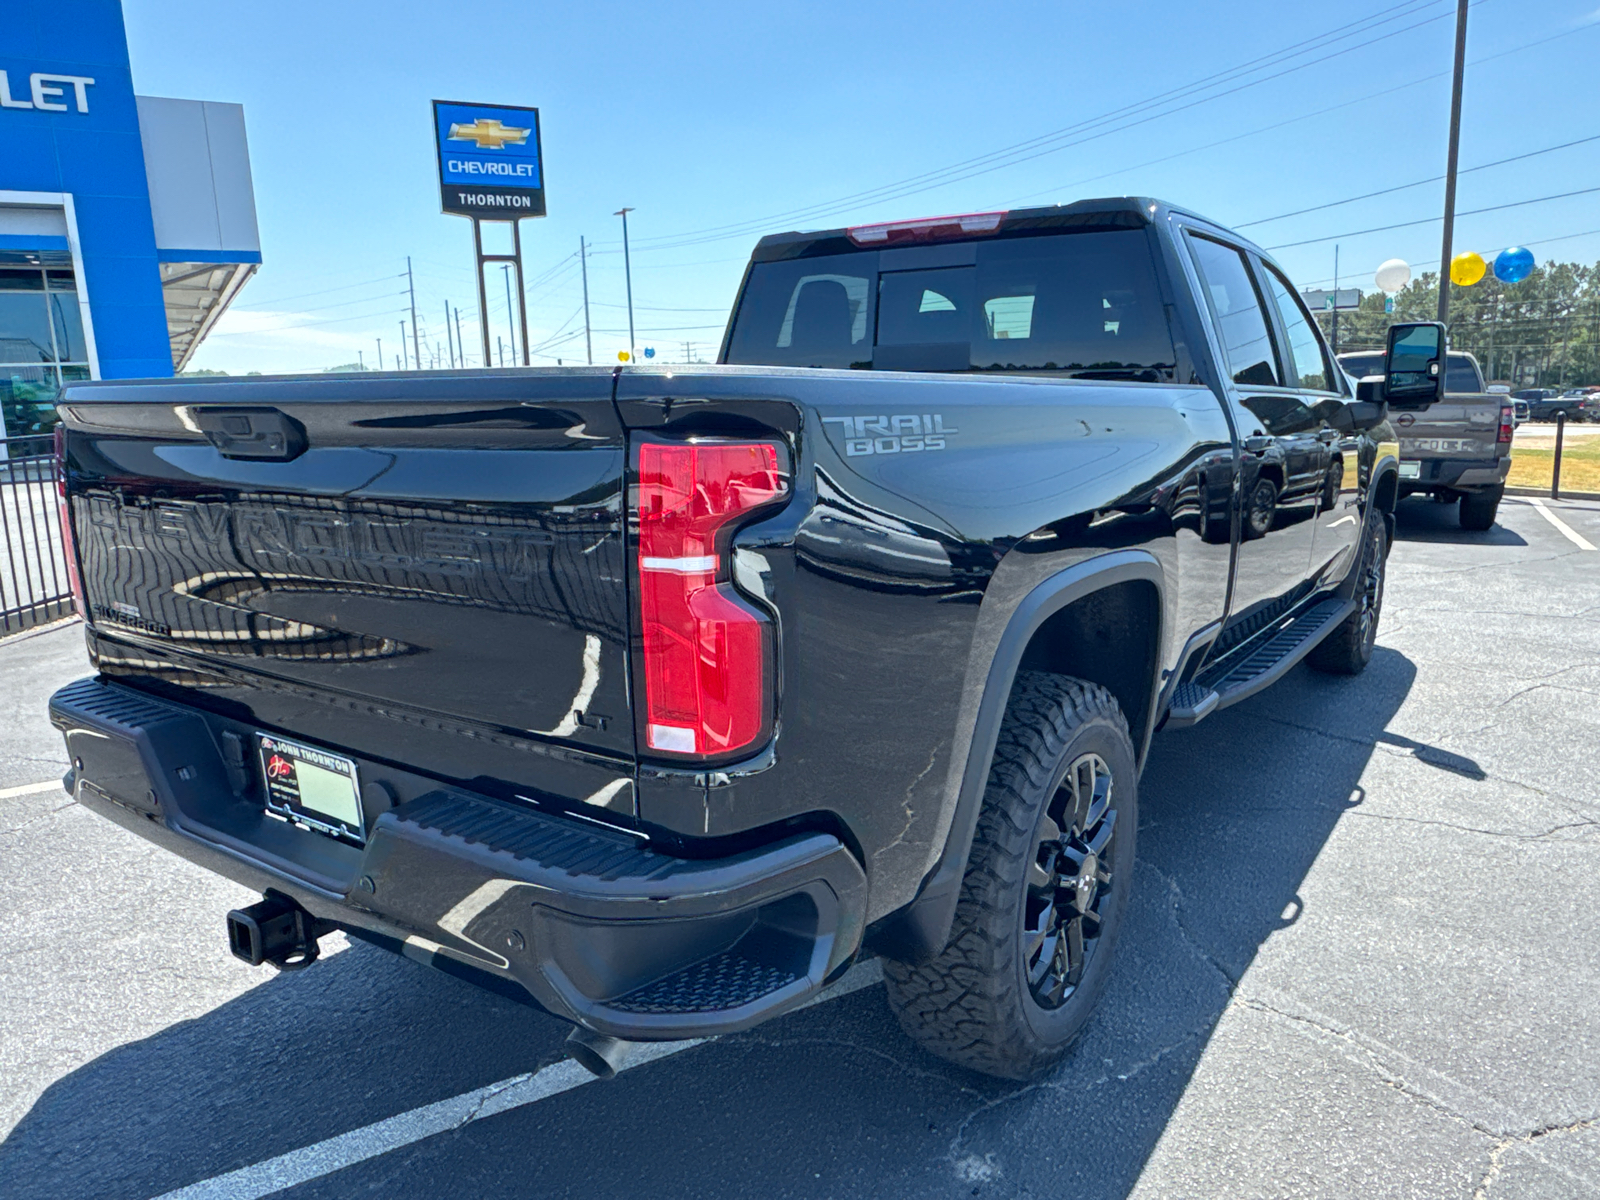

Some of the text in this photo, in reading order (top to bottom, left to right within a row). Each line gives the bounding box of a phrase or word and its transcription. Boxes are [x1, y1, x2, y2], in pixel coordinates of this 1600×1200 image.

[0, 69, 96, 114] LET
[448, 160, 534, 177] CHEVROLET
[458, 193, 531, 207] THORNTON
[821, 414, 959, 438] TRAIL
[845, 434, 946, 456] BOSS
[86, 489, 555, 582] CHEVROLET
[573, 709, 614, 731] LT
[277, 741, 301, 758] JOHN
